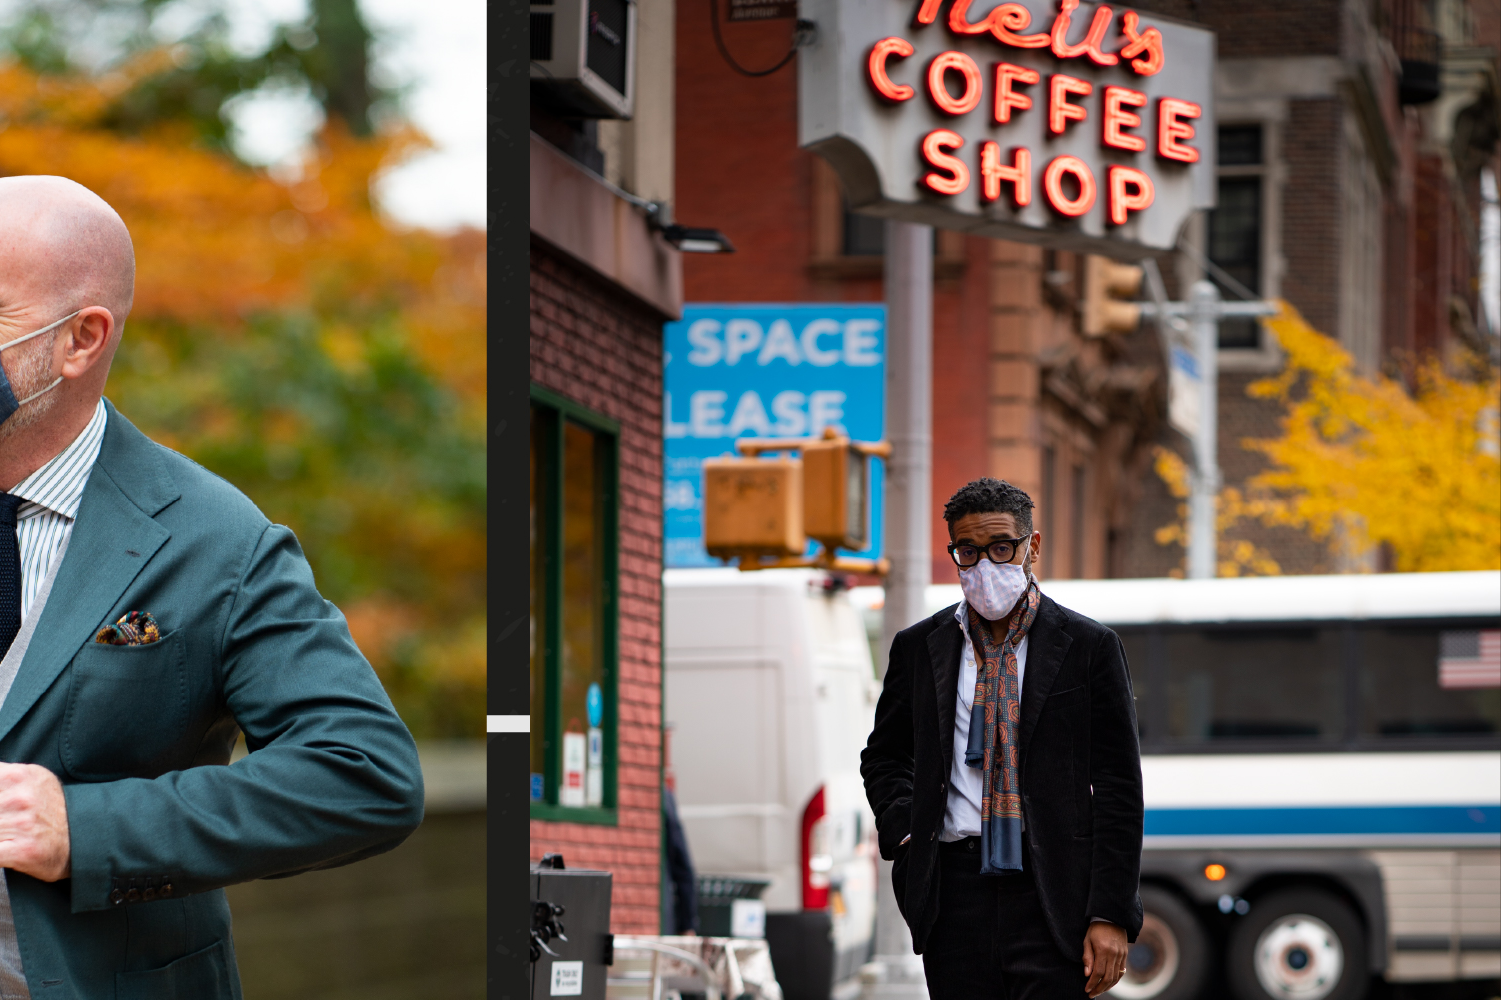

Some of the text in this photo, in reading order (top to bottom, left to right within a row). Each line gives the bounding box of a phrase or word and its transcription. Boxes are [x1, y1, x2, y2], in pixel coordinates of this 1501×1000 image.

[867, 36, 1202, 164] COFFEE
[920, 128, 1156, 225] SHOP
[687, 318, 883, 367] SPACE
[664, 390, 847, 438] LEASE
